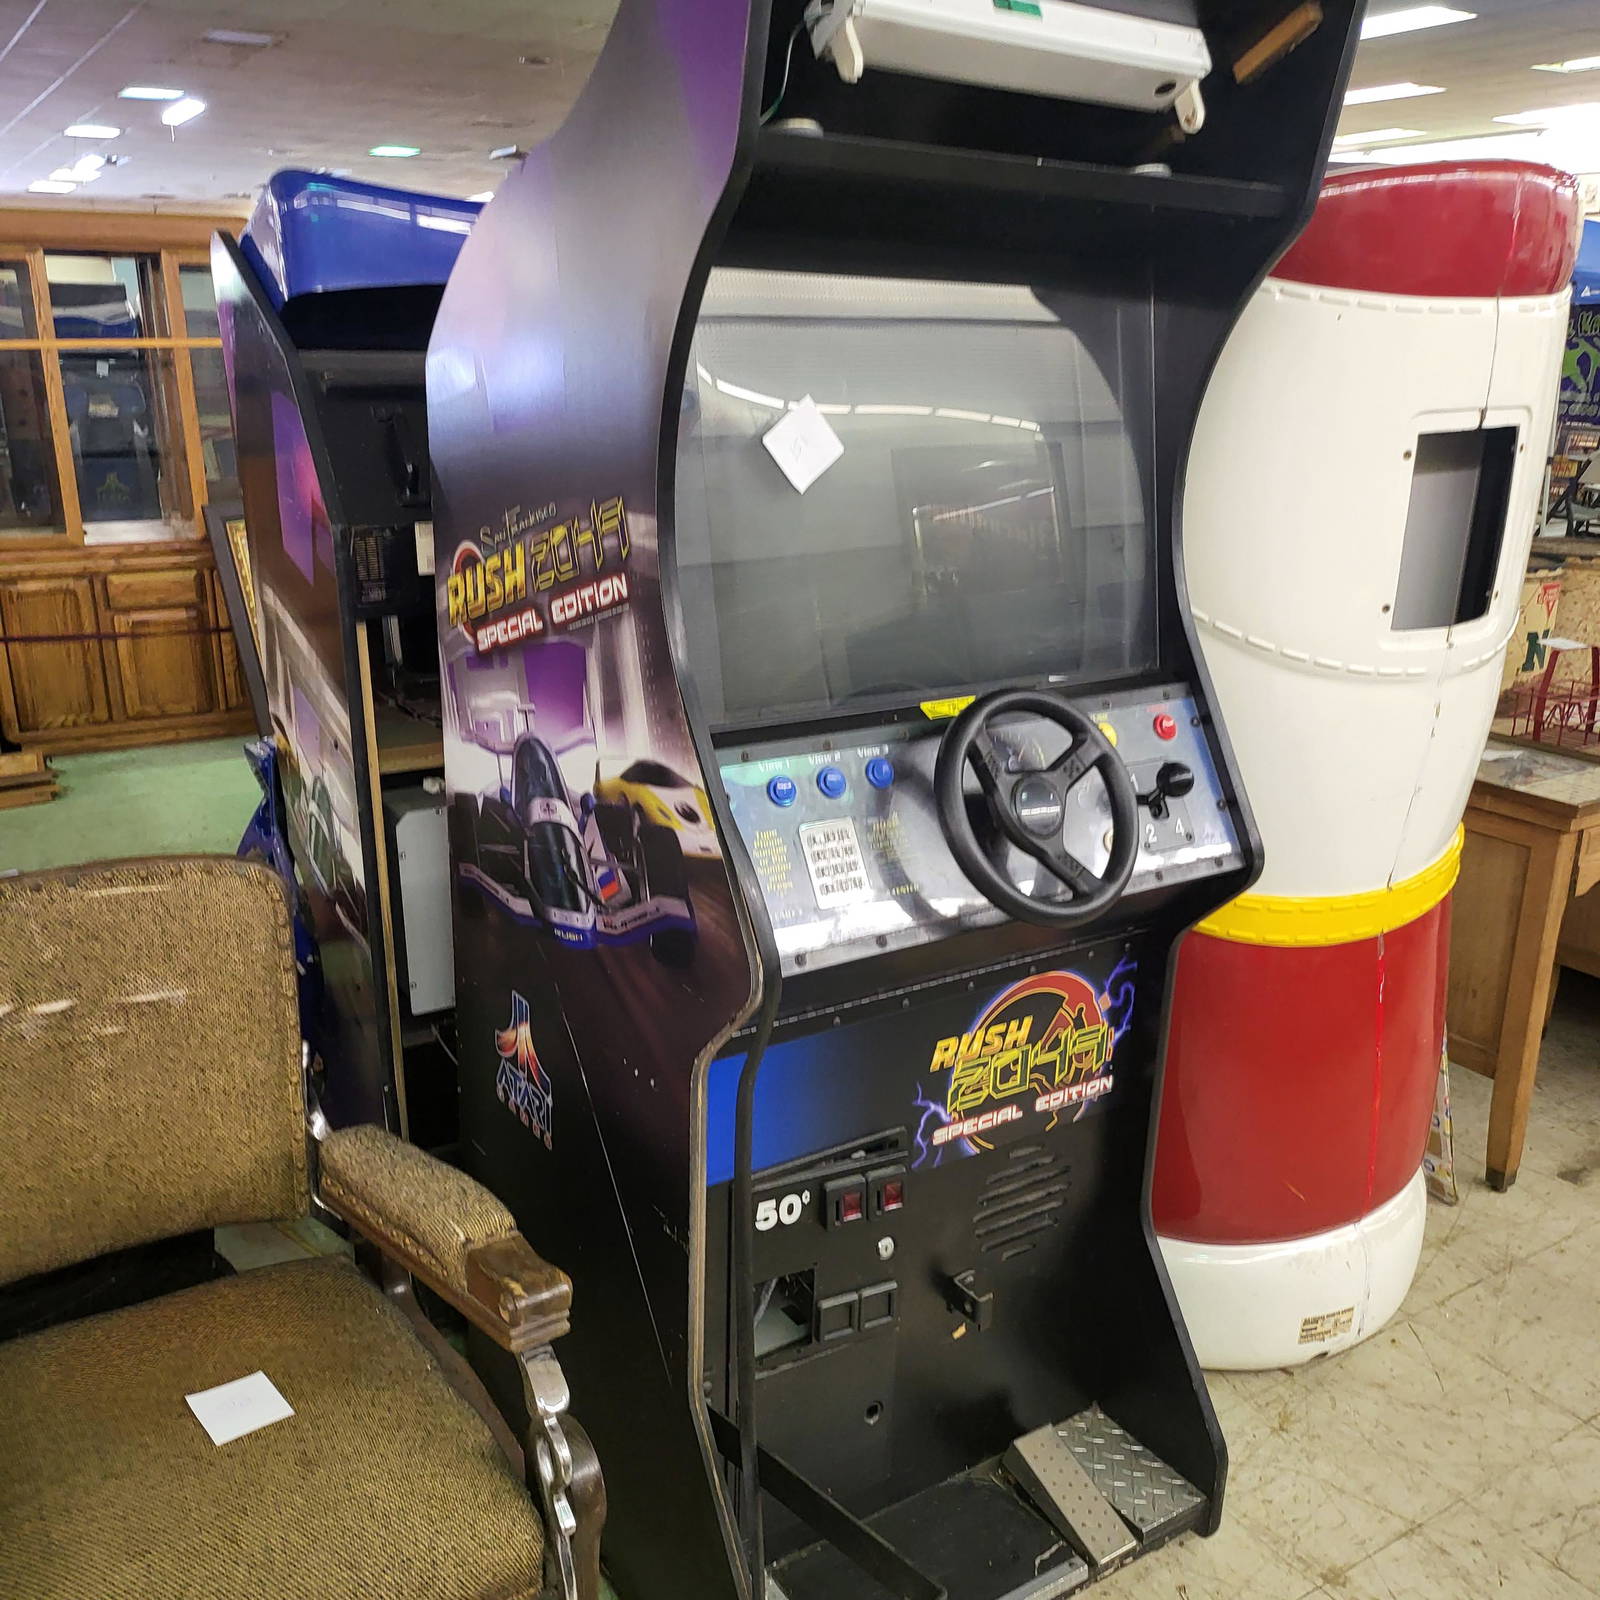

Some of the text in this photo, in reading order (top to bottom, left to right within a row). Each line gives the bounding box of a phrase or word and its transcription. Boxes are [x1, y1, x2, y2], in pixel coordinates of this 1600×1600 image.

[447, 541, 527, 627] RUSH
[476, 608, 544, 652] SPECIAL
[551, 572, 629, 624] EDITION
[1130, 773, 1139, 792] 1
[1145, 823, 1158, 843] 2
[1175, 818, 1185, 836] 4
[929, 1015, 1034, 1073] RUSH
[947, 1021, 1110, 1113] 2049
[496, 1057, 553, 1137] ATARI
[932, 1104, 1024, 1146] SPECIAL
[1035, 1074, 1114, 1112] EDITION
